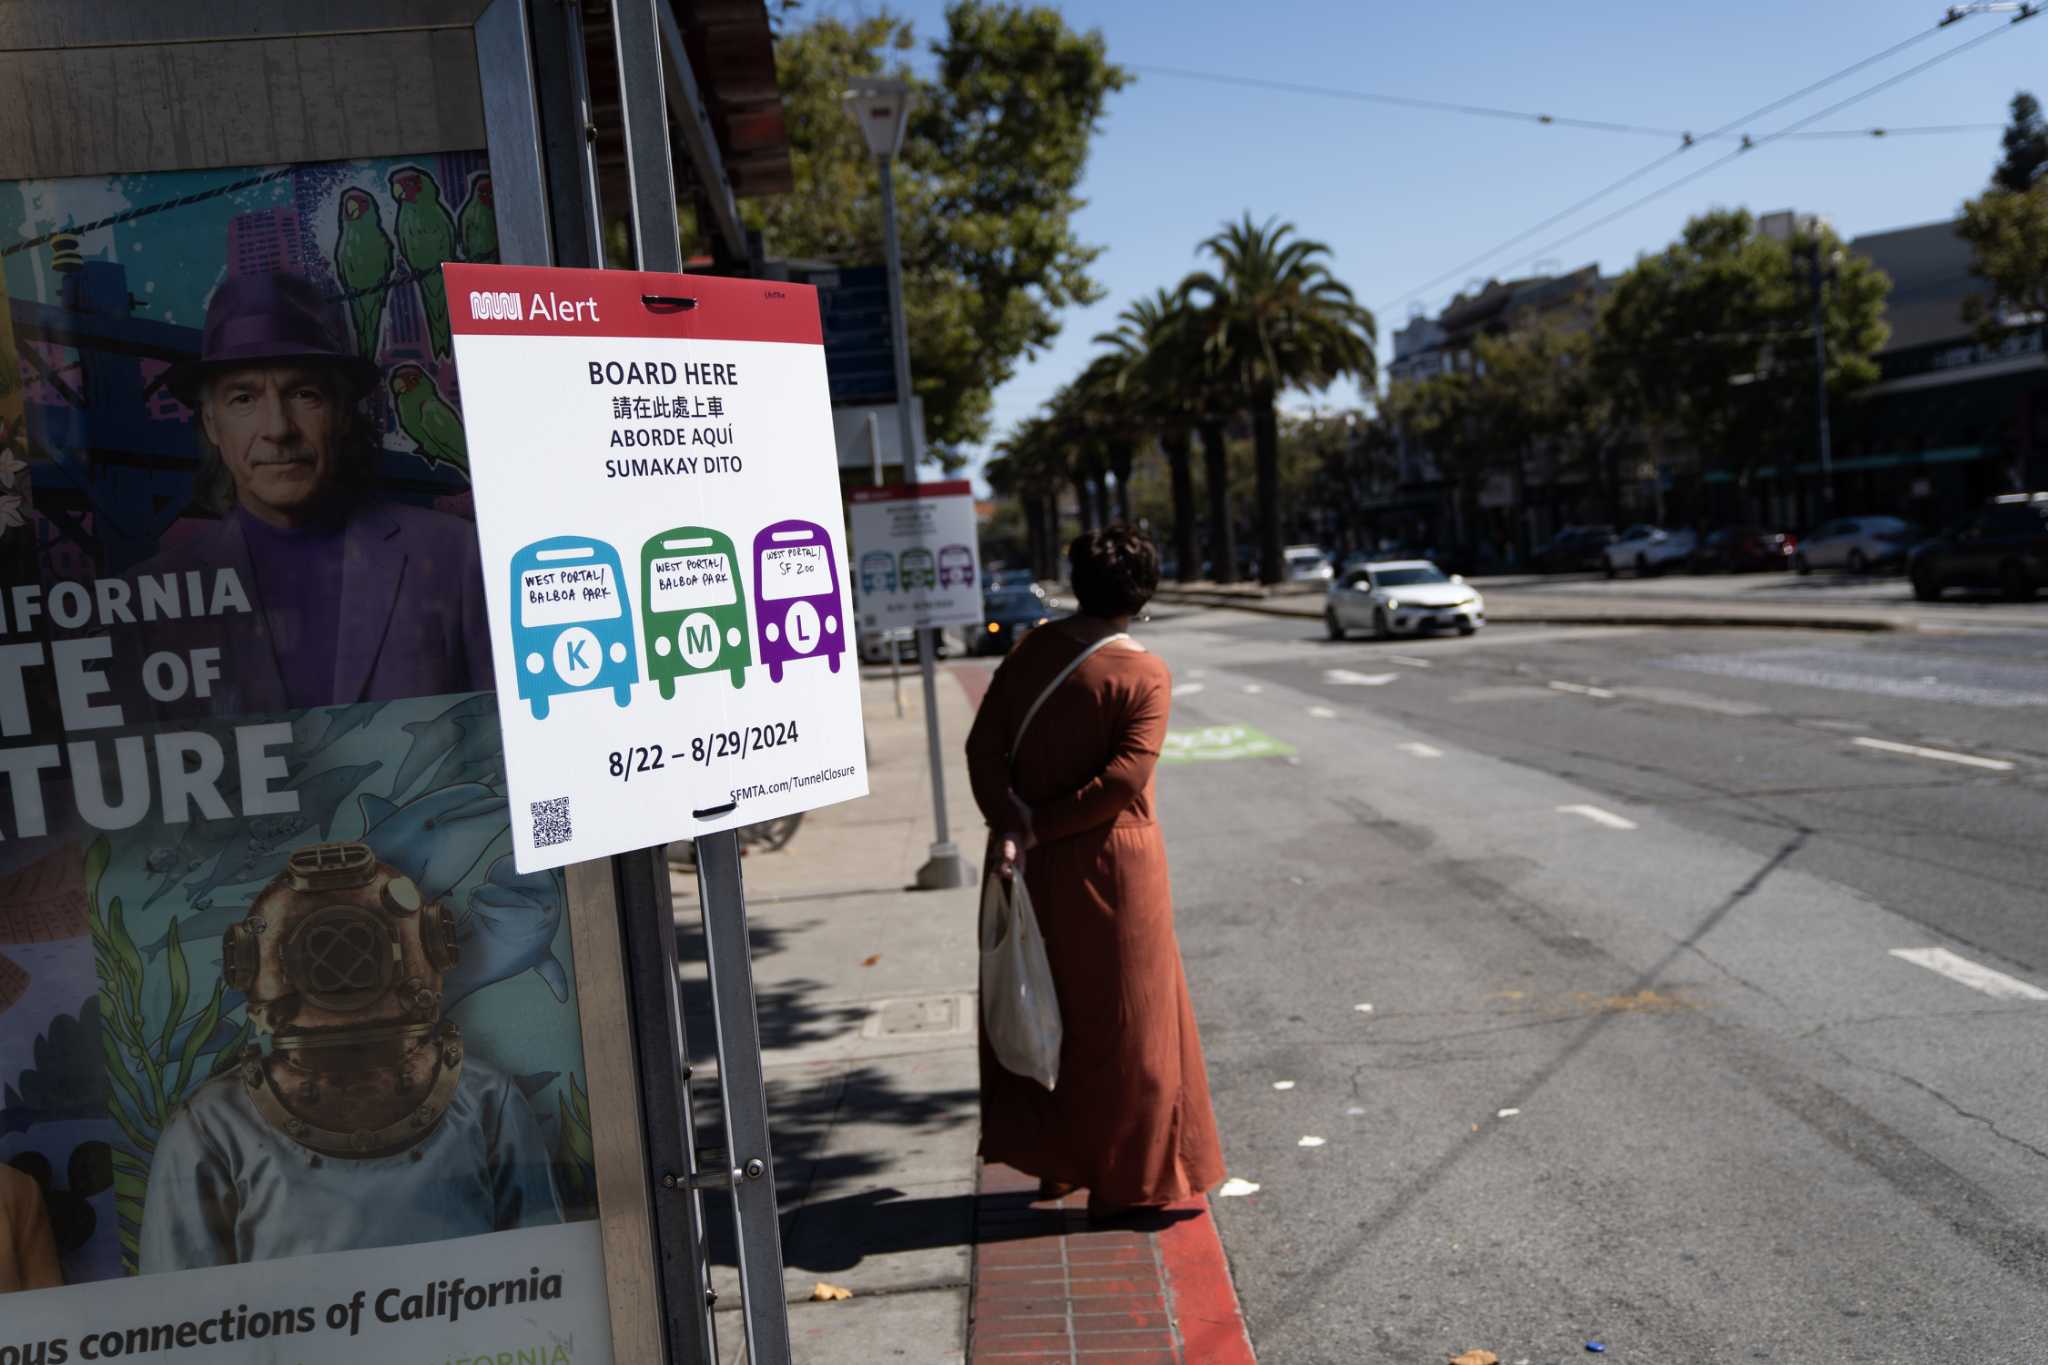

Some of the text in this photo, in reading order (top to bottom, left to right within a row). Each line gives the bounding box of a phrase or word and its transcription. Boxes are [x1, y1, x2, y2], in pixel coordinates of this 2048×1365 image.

[529, 292, 600, 322] Alert
[588, 361, 738, 386] BOARD HERE
[611, 395, 725, 420] 請在此處上車
[610, 423, 734, 448] ABORDE AQUÍ
[605, 455, 743, 479] SUMAKAY DITO
[655, 557, 724, 573] WEST PORTAL/
[766, 550, 786, 560] WEST
[525, 568, 605, 587] WEST PORTAL/
[779, 561, 793, 576] SF
[659, 573, 728, 590] BALBOA PARK
[530, 586, 611, 604] BALBOA PARK
[685, 624, 714, 655] M
[796, 614, 810, 641] L
[566, 639, 590, 671] K
[141, 647, 222, 702] OF
[608, 744, 665, 783] 8/22
[691, 720, 799, 767] 8/29/2024
[0, 721, 300, 842] TURE
[729, 764, 856, 802] SFMTA.com/TunnelClosure
[79, 1304, 316, 1360] connections
[326, 1291, 366, 1337] of
[373, 1267, 563, 1324] California
